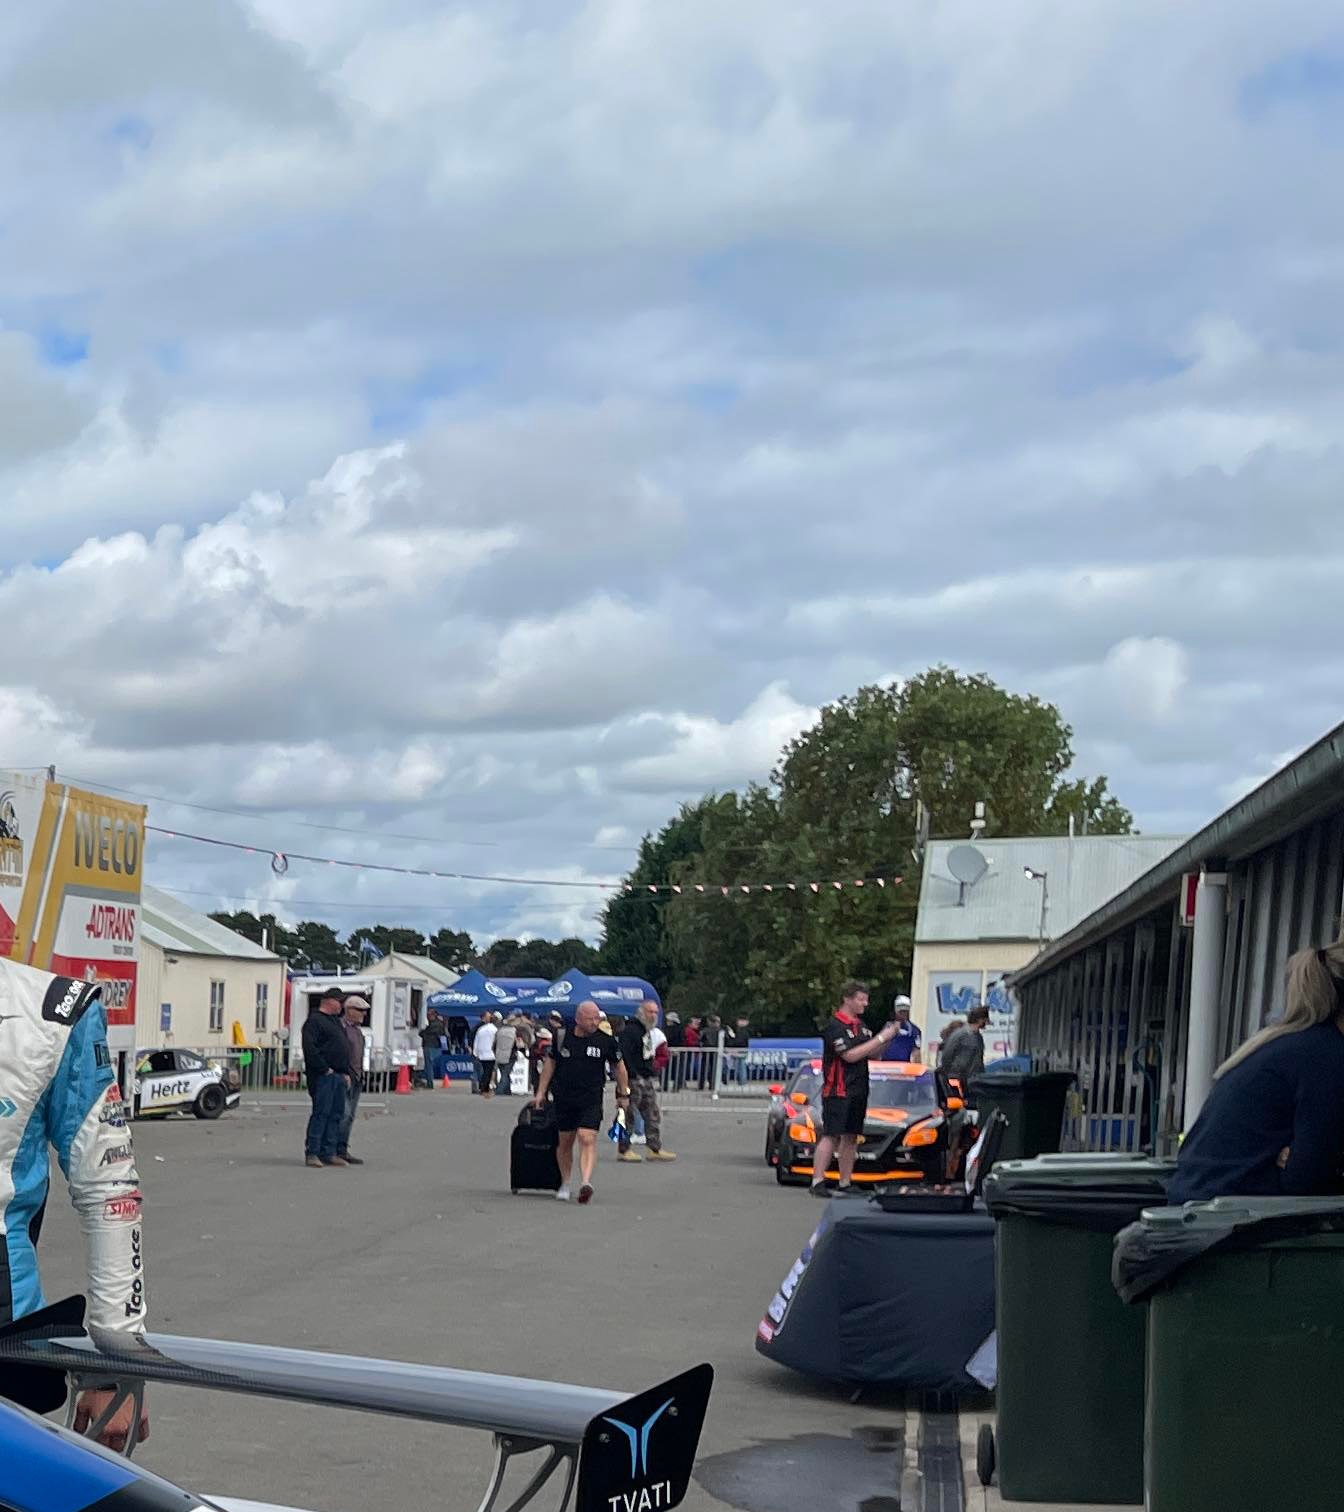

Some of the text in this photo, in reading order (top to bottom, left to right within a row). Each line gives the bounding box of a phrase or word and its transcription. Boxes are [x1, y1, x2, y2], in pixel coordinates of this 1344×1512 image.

[74, 810, 139, 876] IVECO
[86, 904, 136, 942] ADTRANS
[151, 1080, 190, 1098] Hertz
